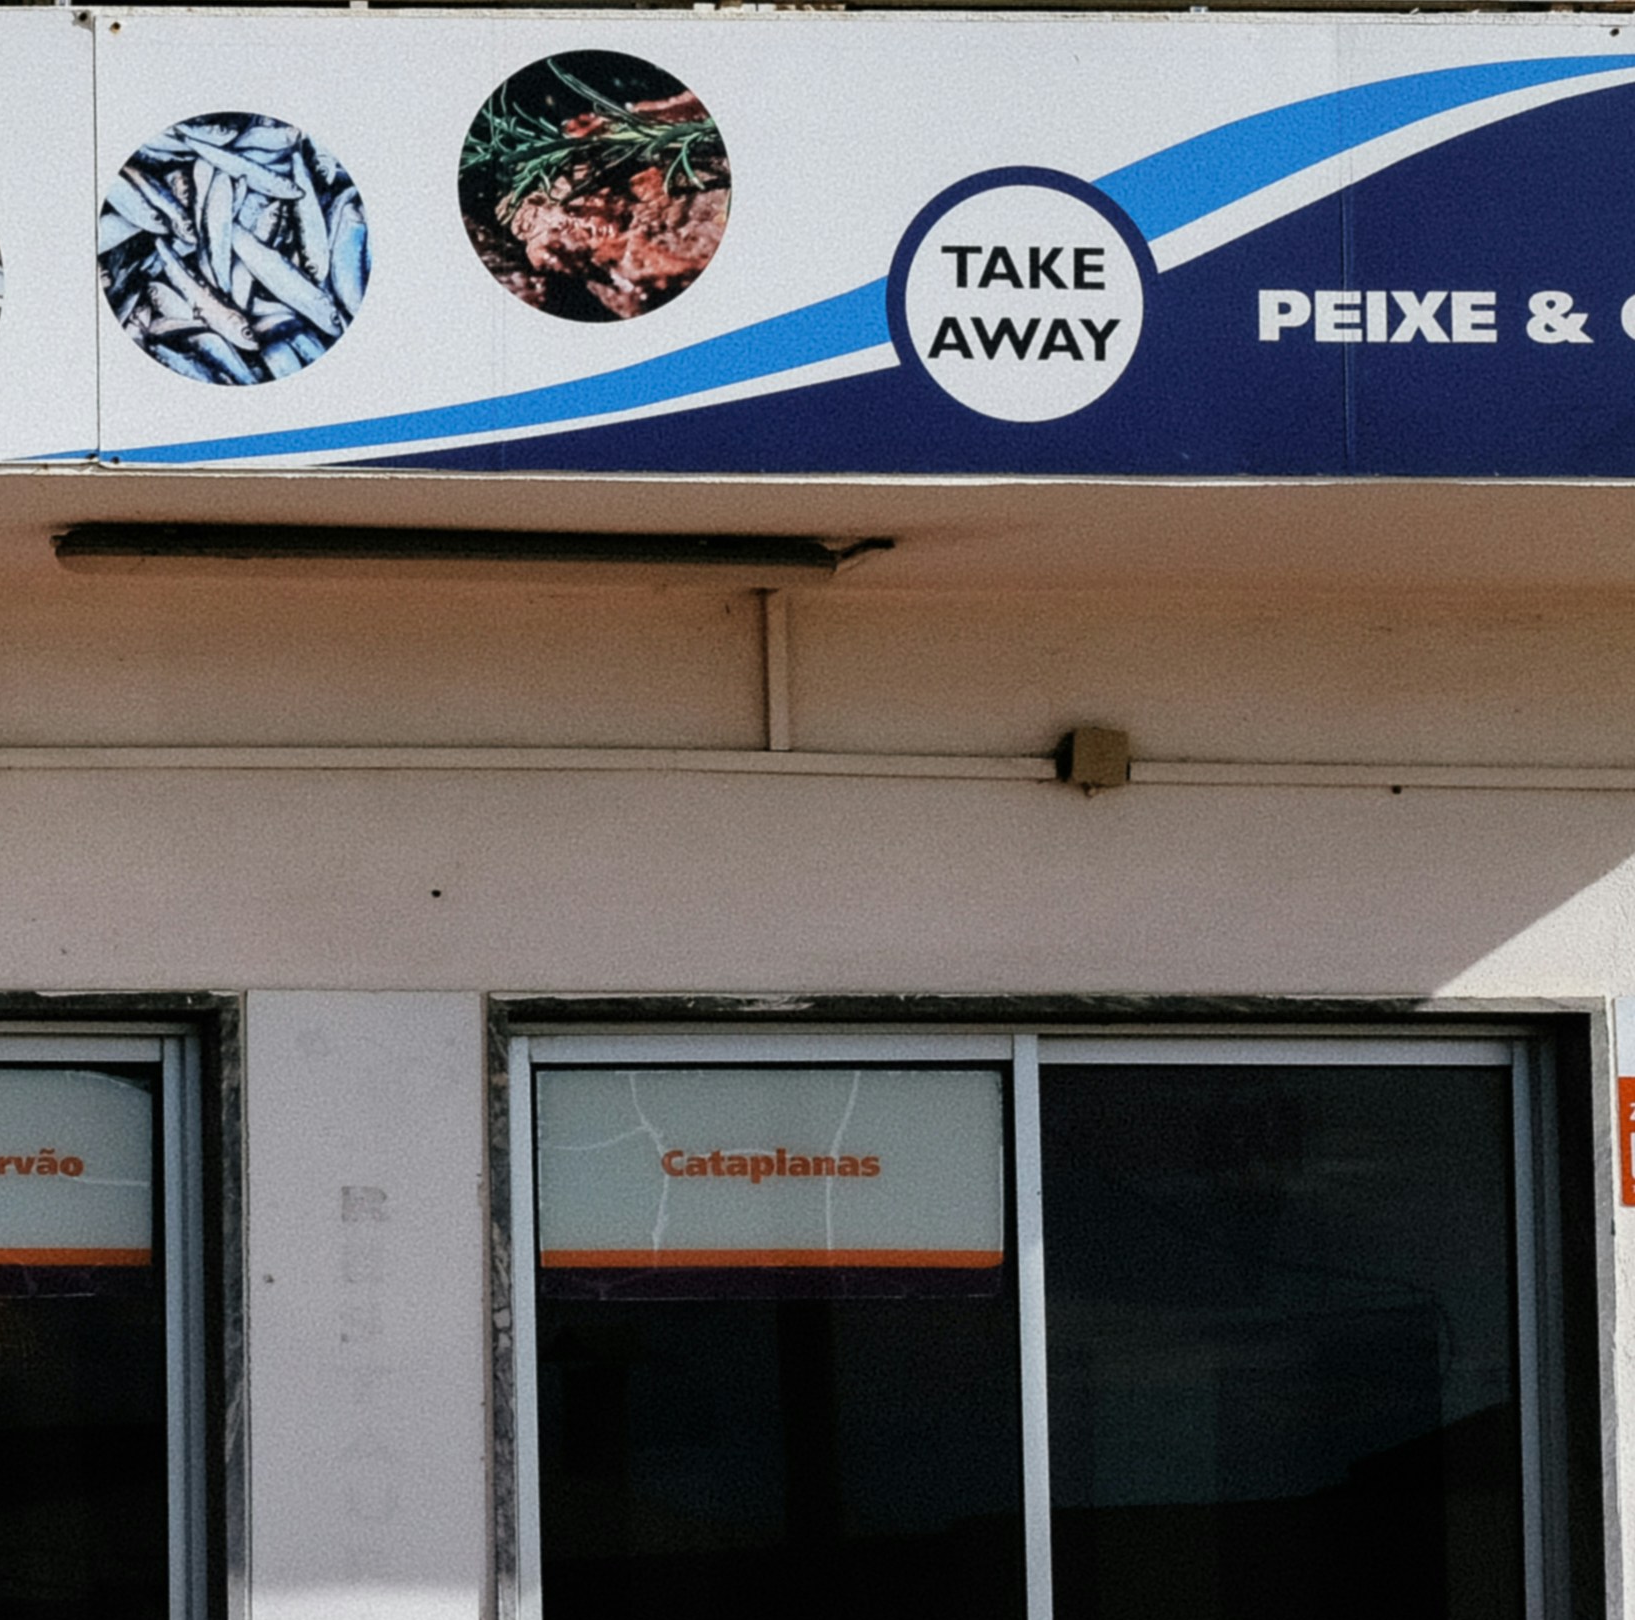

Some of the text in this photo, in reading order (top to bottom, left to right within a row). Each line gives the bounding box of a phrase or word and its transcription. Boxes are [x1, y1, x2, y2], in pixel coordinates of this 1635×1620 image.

[942, 246, 1105, 290] TAKE
[1259, 290, 1497, 342] PEIXE
[1526, 291, 1593, 343] &
[928, 317, 1119, 361] AWAY
[662, 1148, 880, 1184] Cataplanas
